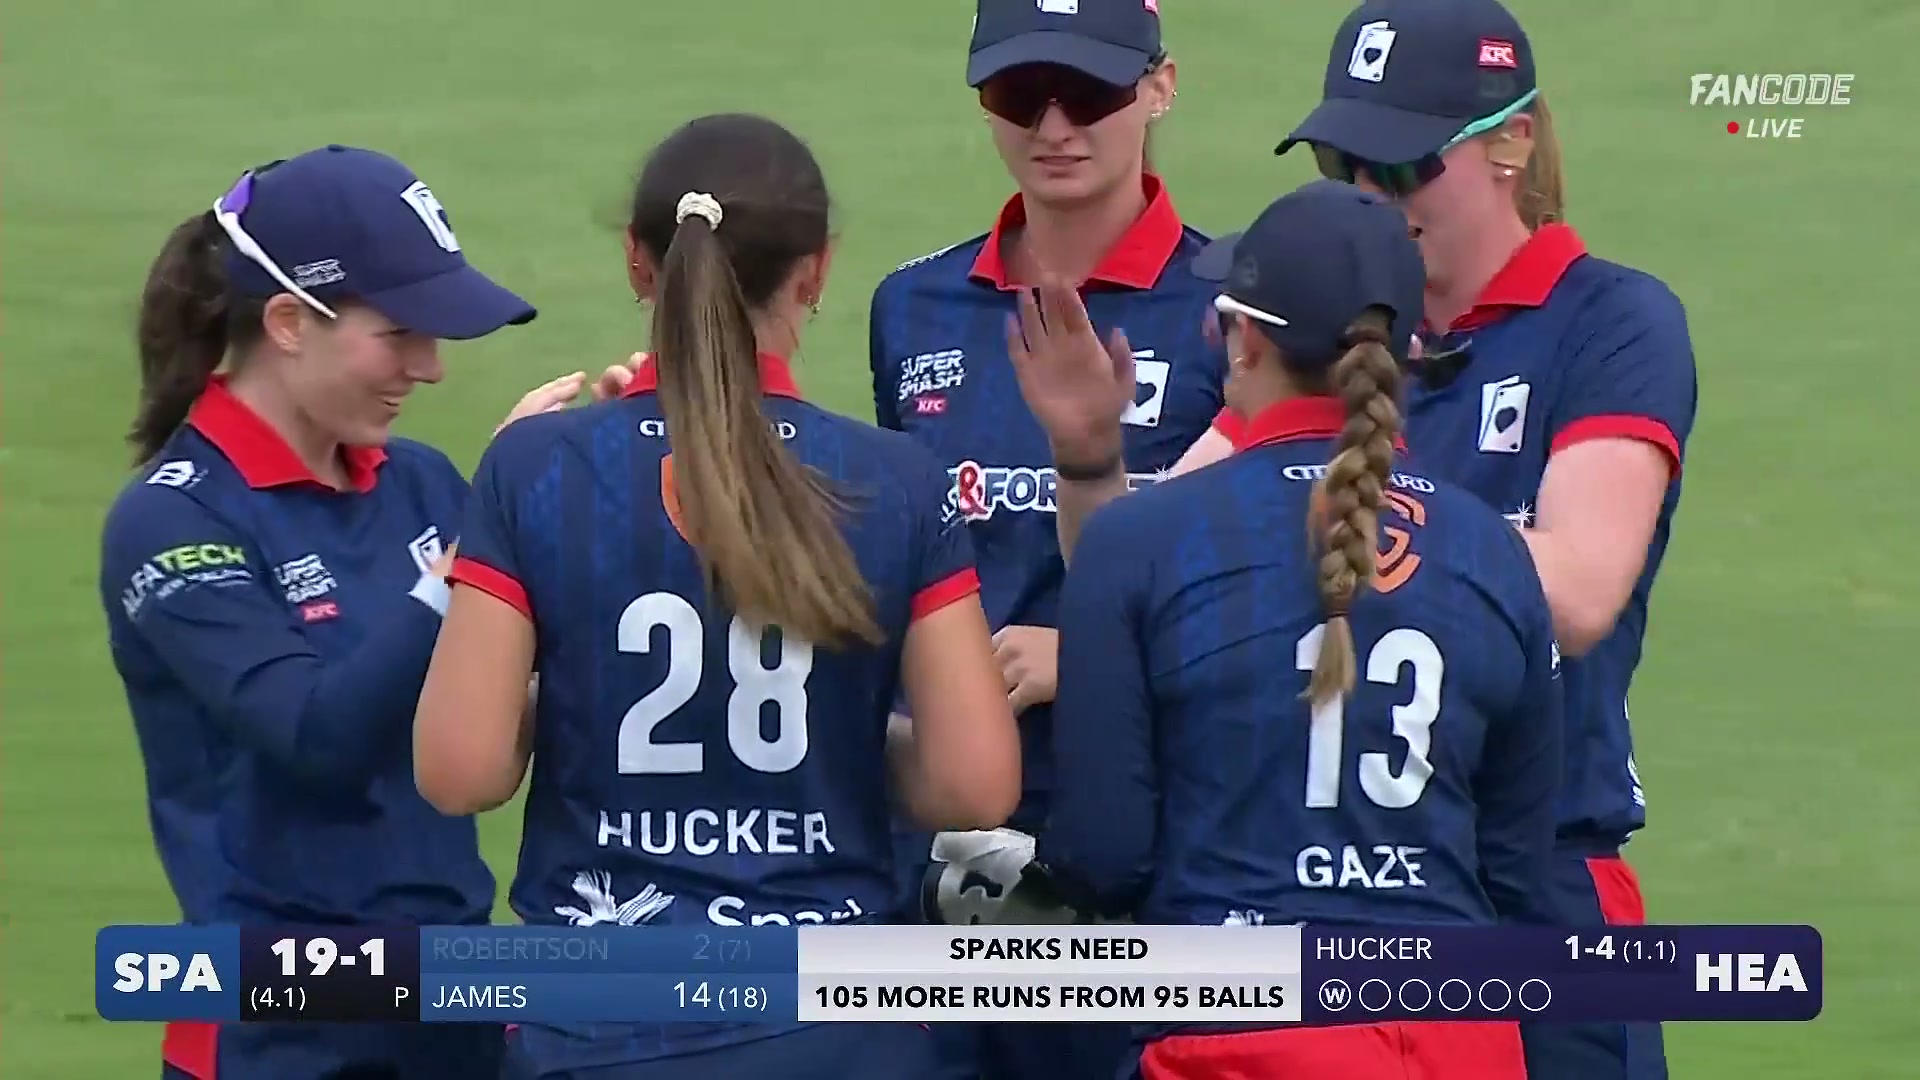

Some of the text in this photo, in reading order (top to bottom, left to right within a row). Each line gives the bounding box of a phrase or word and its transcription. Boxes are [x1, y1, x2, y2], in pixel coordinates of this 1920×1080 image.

[898, 368, 965, 401] SMASH
[900, 349, 965, 380] SUPER
[616, 591, 814, 775] 28
[1295, 618, 1445, 809] 13
[597, 808, 836, 856] HUCKER
[1295, 845, 1428, 889] GAZE
